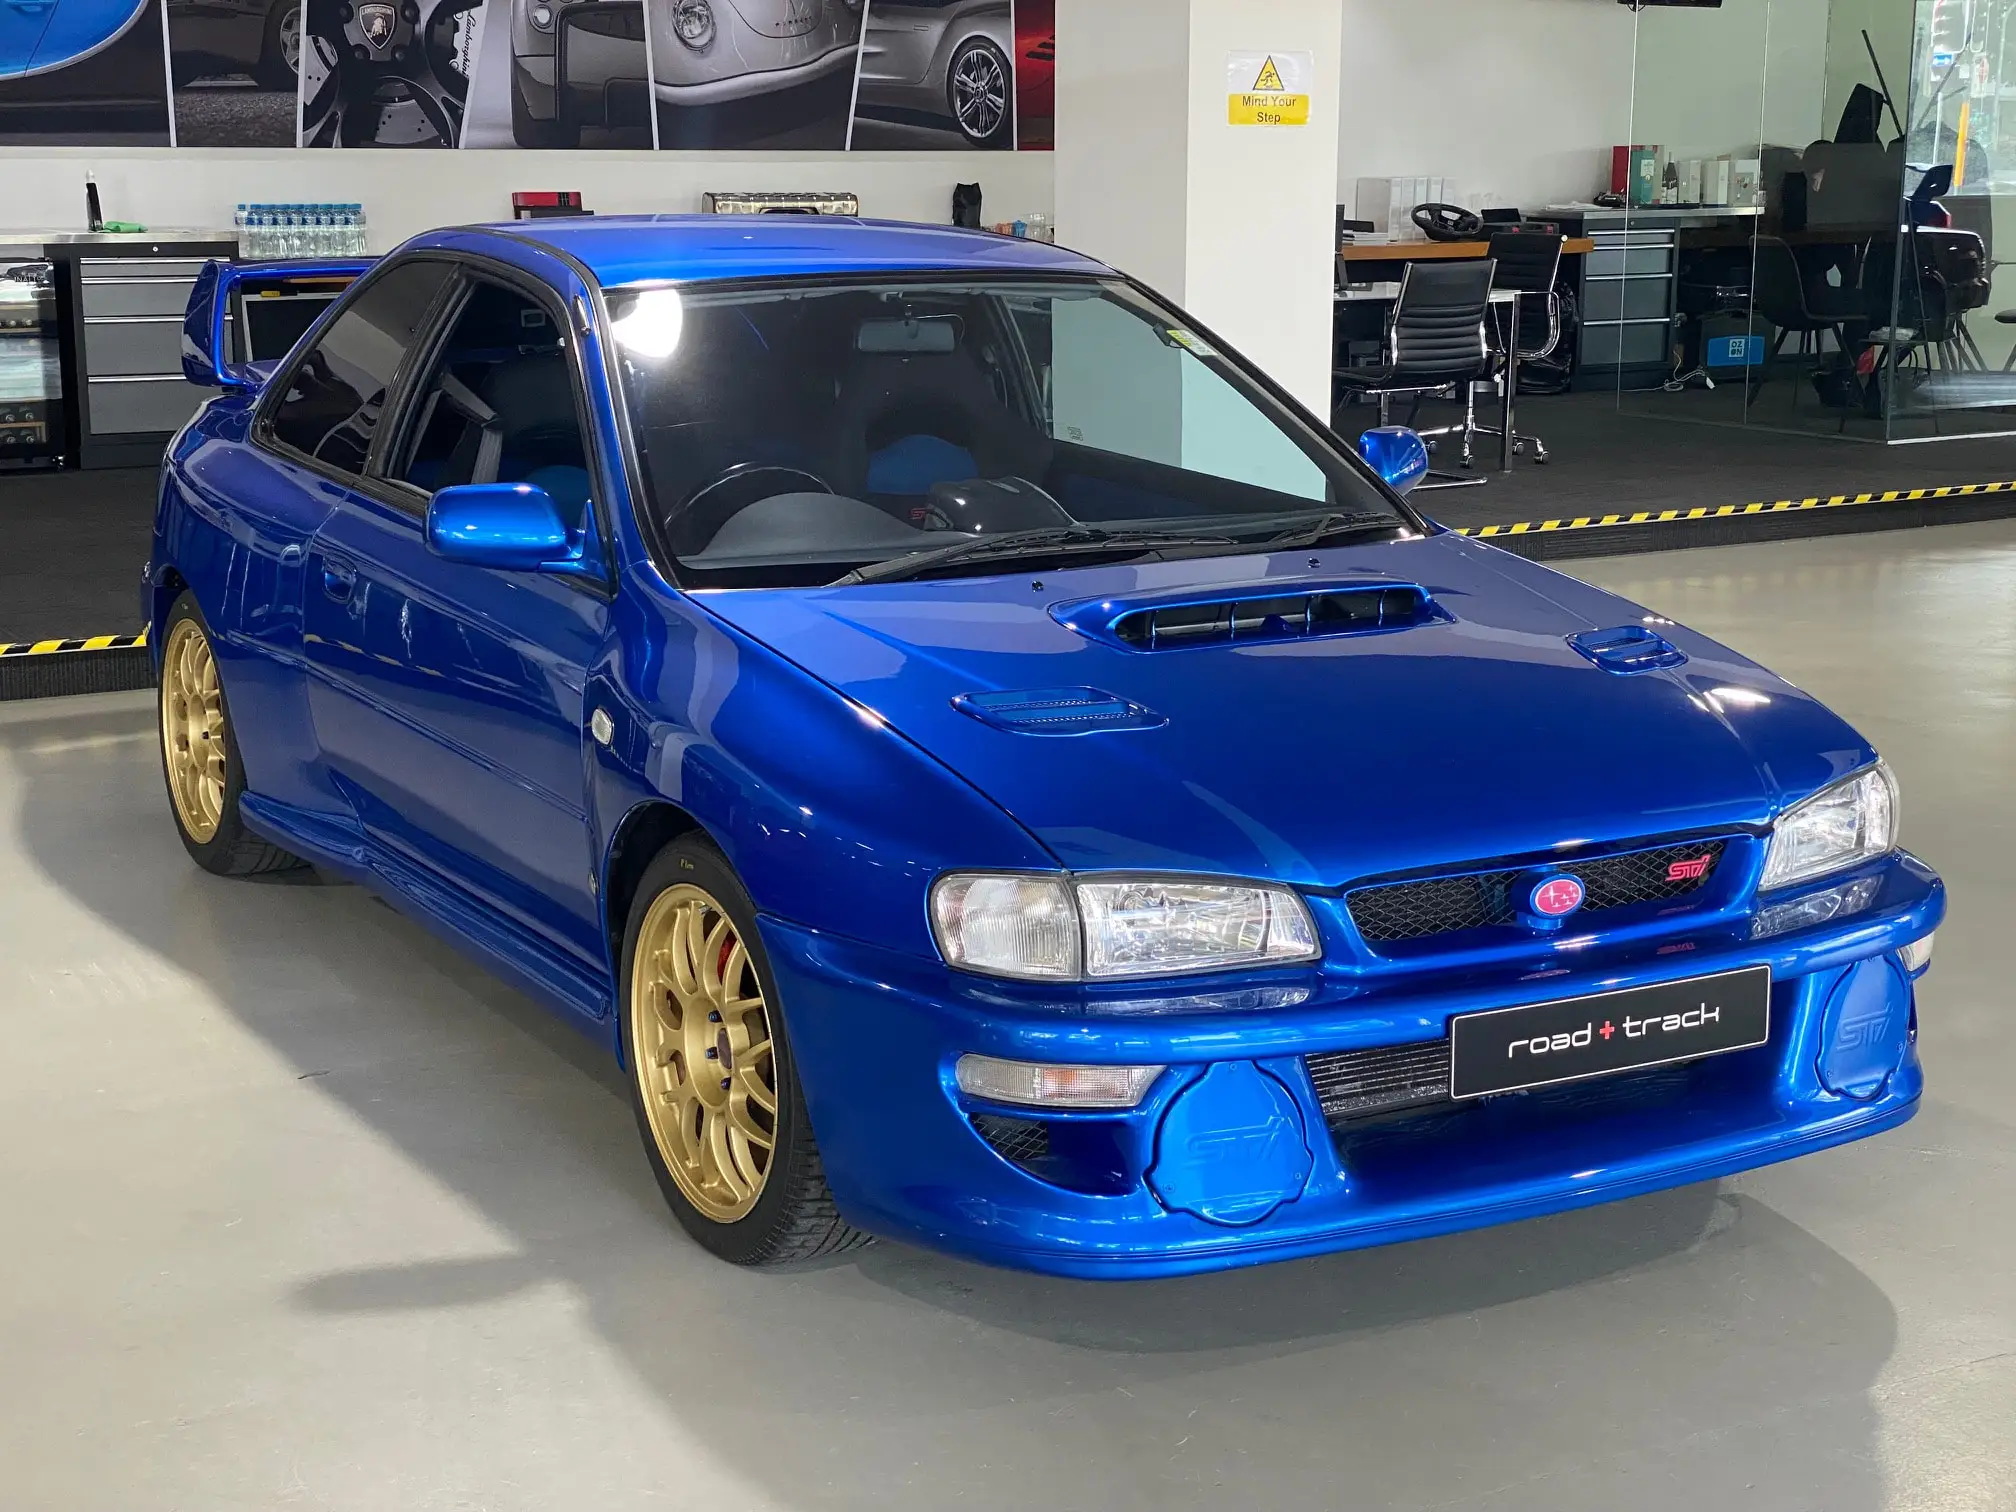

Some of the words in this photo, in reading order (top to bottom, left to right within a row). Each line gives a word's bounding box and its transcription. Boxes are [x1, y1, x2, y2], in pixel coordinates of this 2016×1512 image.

[1242, 95, 1268, 107] Mind
[1270, 95, 1297, 107] Your
[1256, 111, 1281, 125] Step
[1508, 1021, 1592, 1059] road
[1622, 1002, 1720, 1038] track
